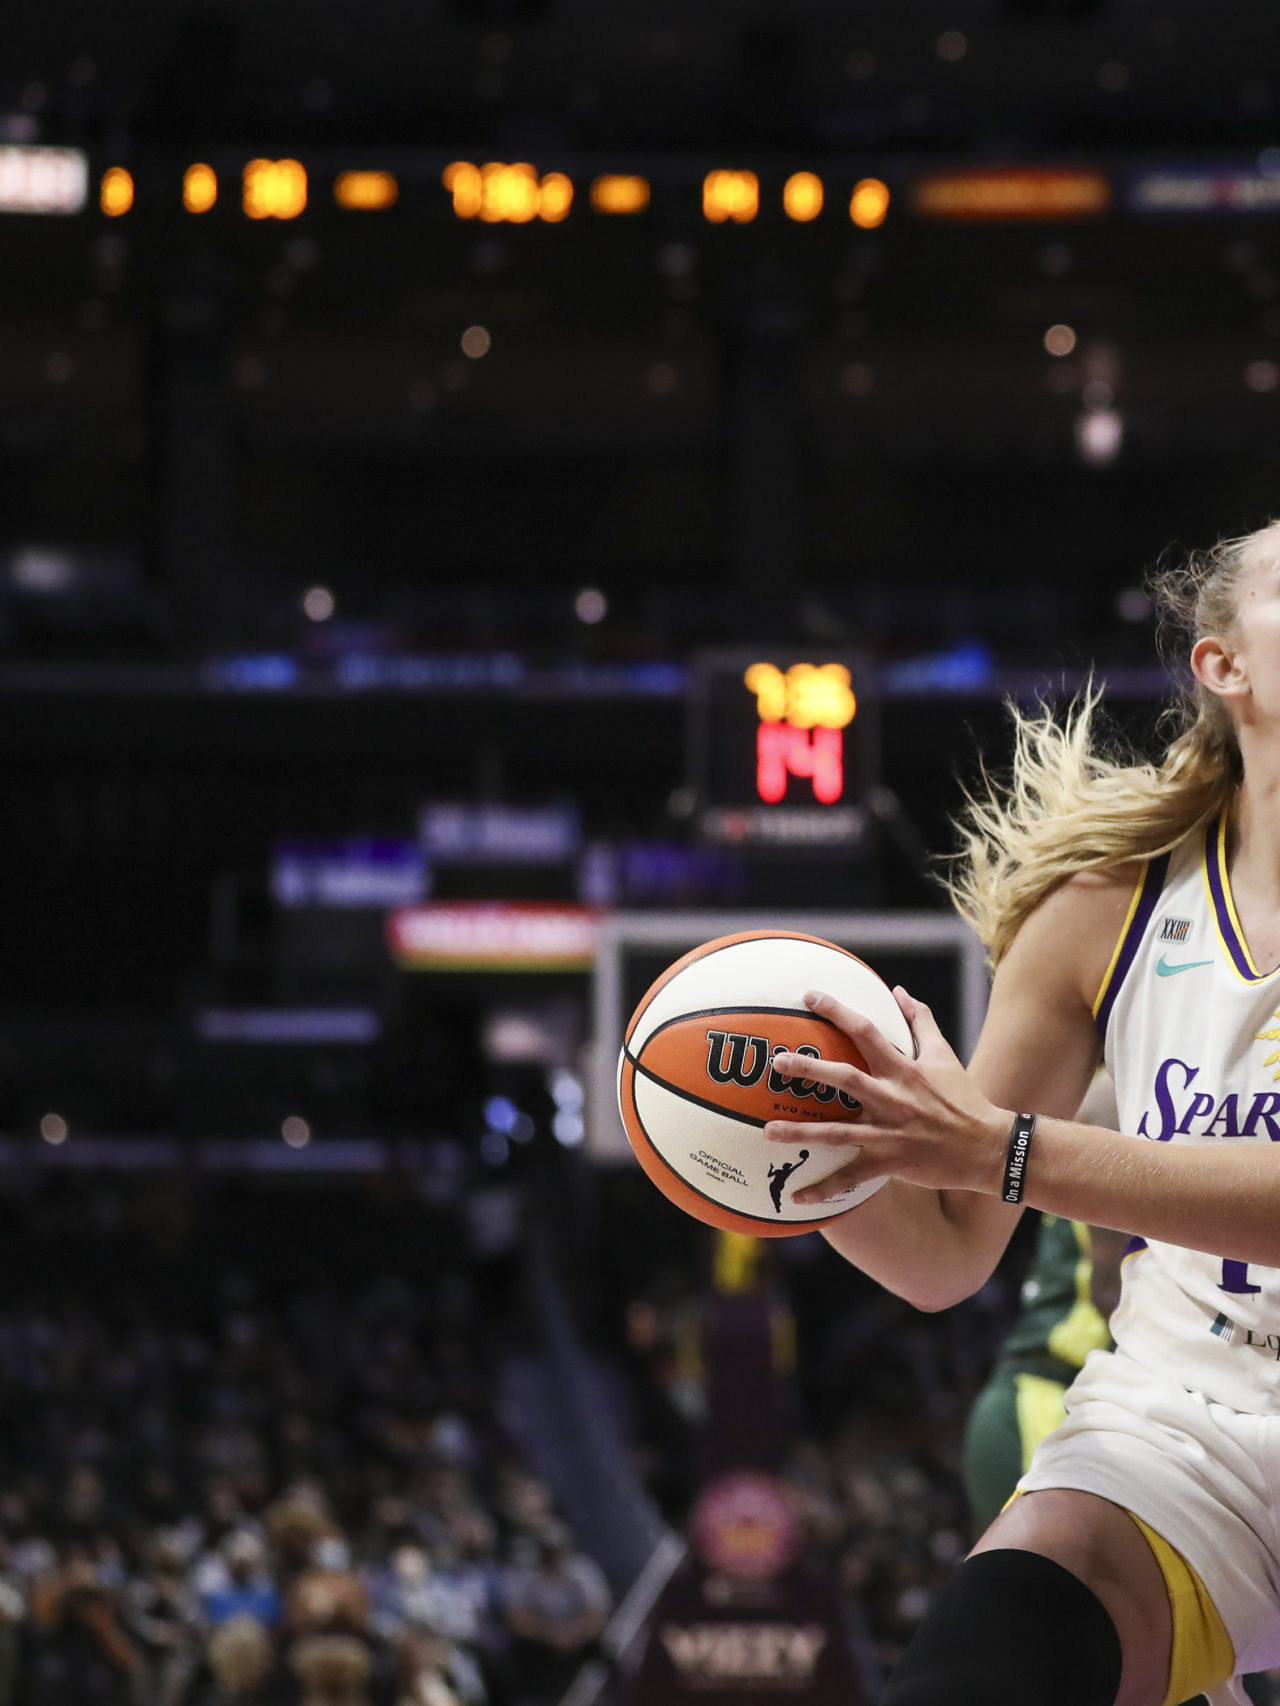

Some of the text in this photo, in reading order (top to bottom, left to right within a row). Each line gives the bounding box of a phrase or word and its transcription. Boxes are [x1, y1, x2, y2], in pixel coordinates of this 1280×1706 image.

[689, 1153, 720, 1174] GAME
[721, 1171, 749, 1187] BALL
[699, 1150, 745, 1178] OFFICIAL
[1008, 1130, 1030, 1179] Mission
[1005, 1189, 1020, 1202] On
